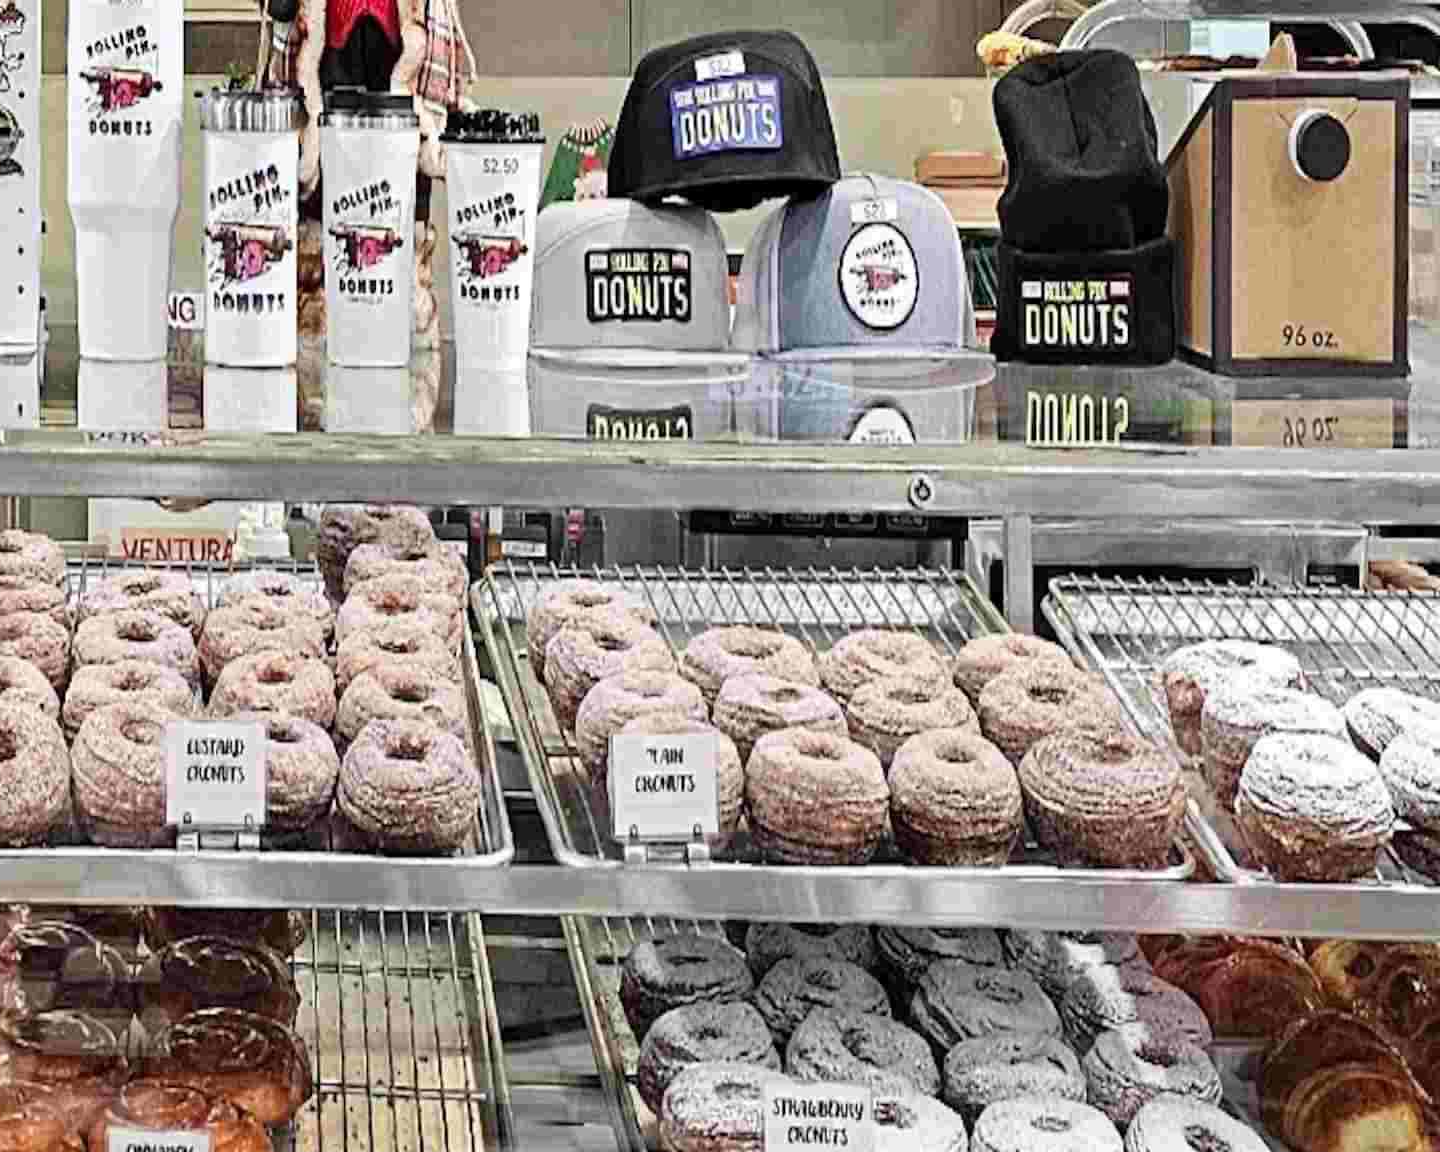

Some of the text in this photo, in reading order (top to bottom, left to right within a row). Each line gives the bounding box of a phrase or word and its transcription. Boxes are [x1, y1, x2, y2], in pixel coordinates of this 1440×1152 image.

[89, 120, 153, 135] DONUTS
[680, 104, 777, 151] DONUTS
[338, 279, 394, 294] DONUTS
[460, 283, 521, 302] DONUTS
[593, 275, 689, 316] DONUTS
[213, 290, 286, 314] DONUTS
[1025, 303, 1129, 345] DONUTS
[1282, 324, 1308, 347] 96
[121, 536, 235, 561] VENTURA
[186, 765, 245, 783] CRONUTS
[634, 775, 696, 793] CRONUTS
[787, 1126, 849, 1146] CRONUTS
